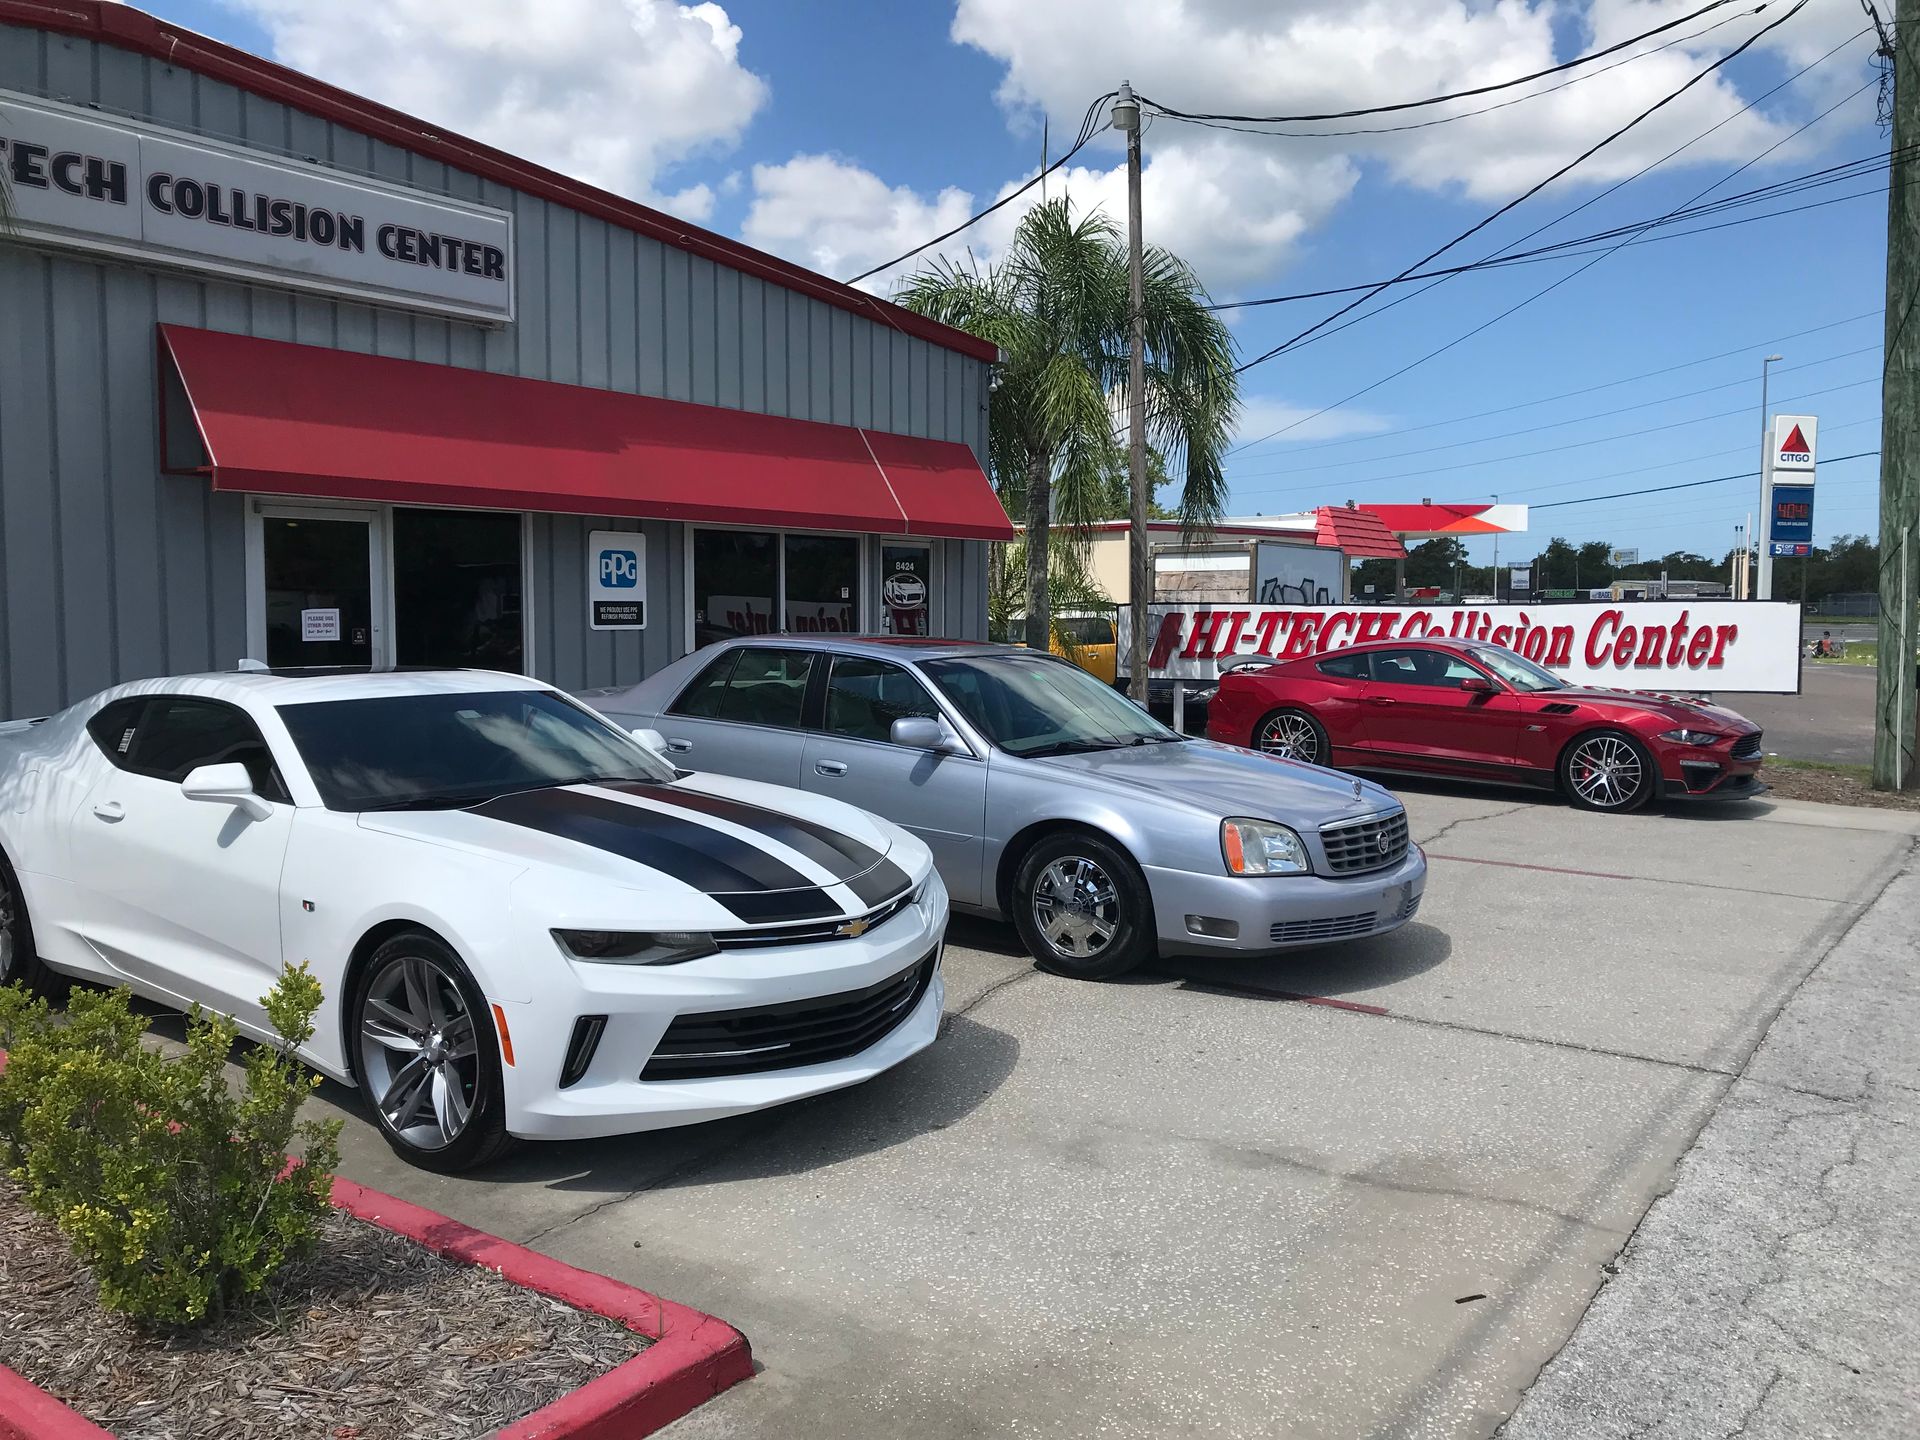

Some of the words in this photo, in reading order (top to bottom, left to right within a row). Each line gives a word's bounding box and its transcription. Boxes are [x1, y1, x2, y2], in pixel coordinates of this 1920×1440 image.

[0, 137, 127, 205] ECH
[146, 172, 364, 253] COLLISION
[376, 222, 504, 281] CENTER
[1780, 453, 1810, 463] CITGO
[601, 553, 636, 585] PPG
[895, 561, 915, 571] 8424
[1178, 610, 1402, 660] HI-TECH
[1584, 609, 1739, 668] Center
